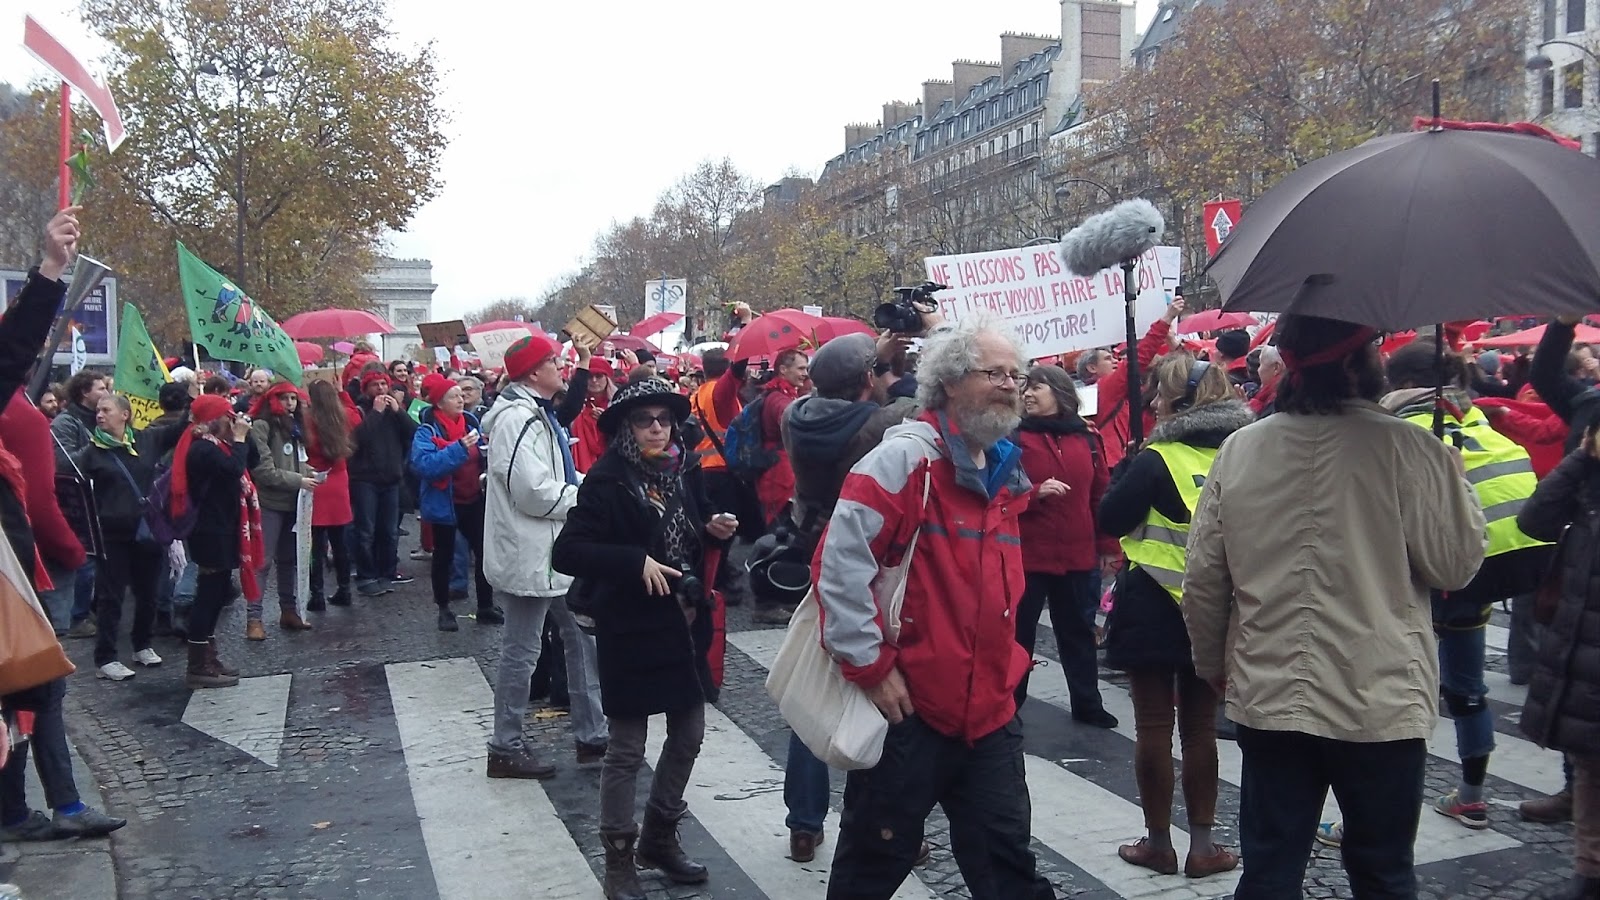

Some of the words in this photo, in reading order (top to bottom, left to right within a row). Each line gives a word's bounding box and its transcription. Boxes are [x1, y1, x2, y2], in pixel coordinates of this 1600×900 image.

[931, 264, 954, 289] NE
[1033, 250, 1060, 277] PAS
[938, 297, 958, 322] ET
[1104, 272, 1125, 296] LA
